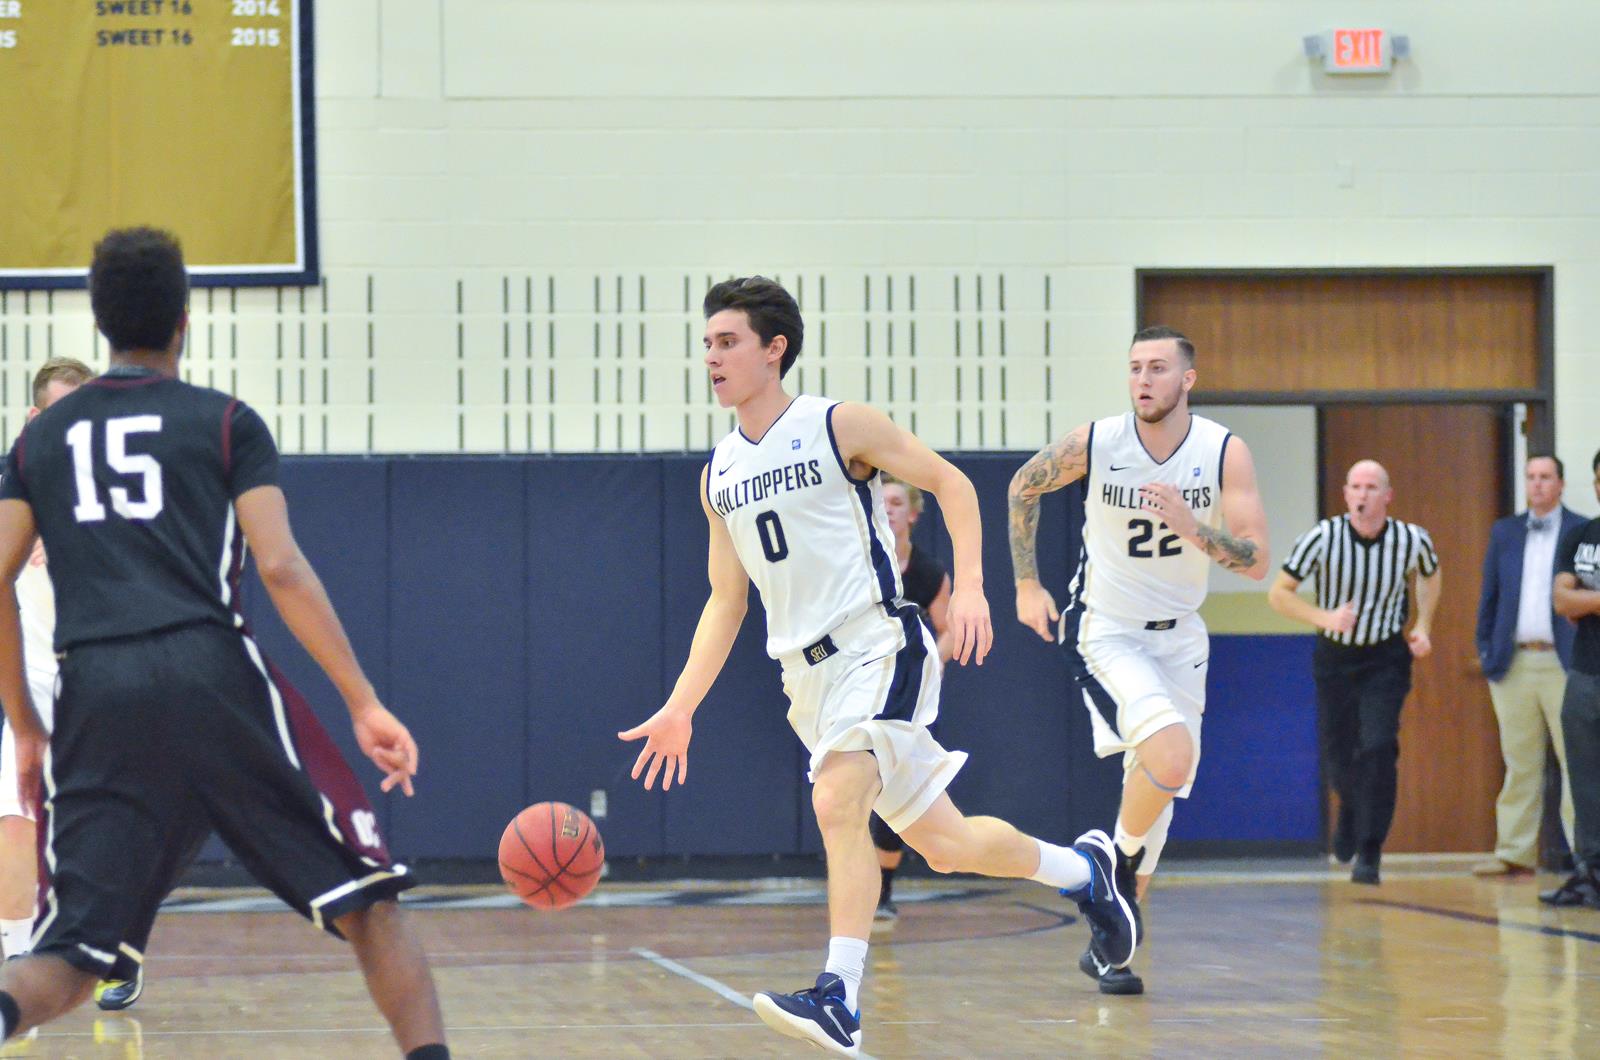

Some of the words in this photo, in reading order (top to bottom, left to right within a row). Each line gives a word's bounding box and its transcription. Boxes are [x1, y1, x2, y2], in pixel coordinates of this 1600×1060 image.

[96, 0, 163, 16] SWEET
[172, 0, 193, 16] 16
[231, 0, 281, 17] 2014
[96, 29, 164, 47] SWEET
[172, 29, 193, 46] 16
[231, 27, 281, 47] 2015
[1334, 28, 1384, 67] EXIT
[66, 414, 163, 522] 15
[715, 459, 823, 516] HILLTOPPERS
[755, 509, 789, 563] 0
[1128, 518, 1183, 559] 22
